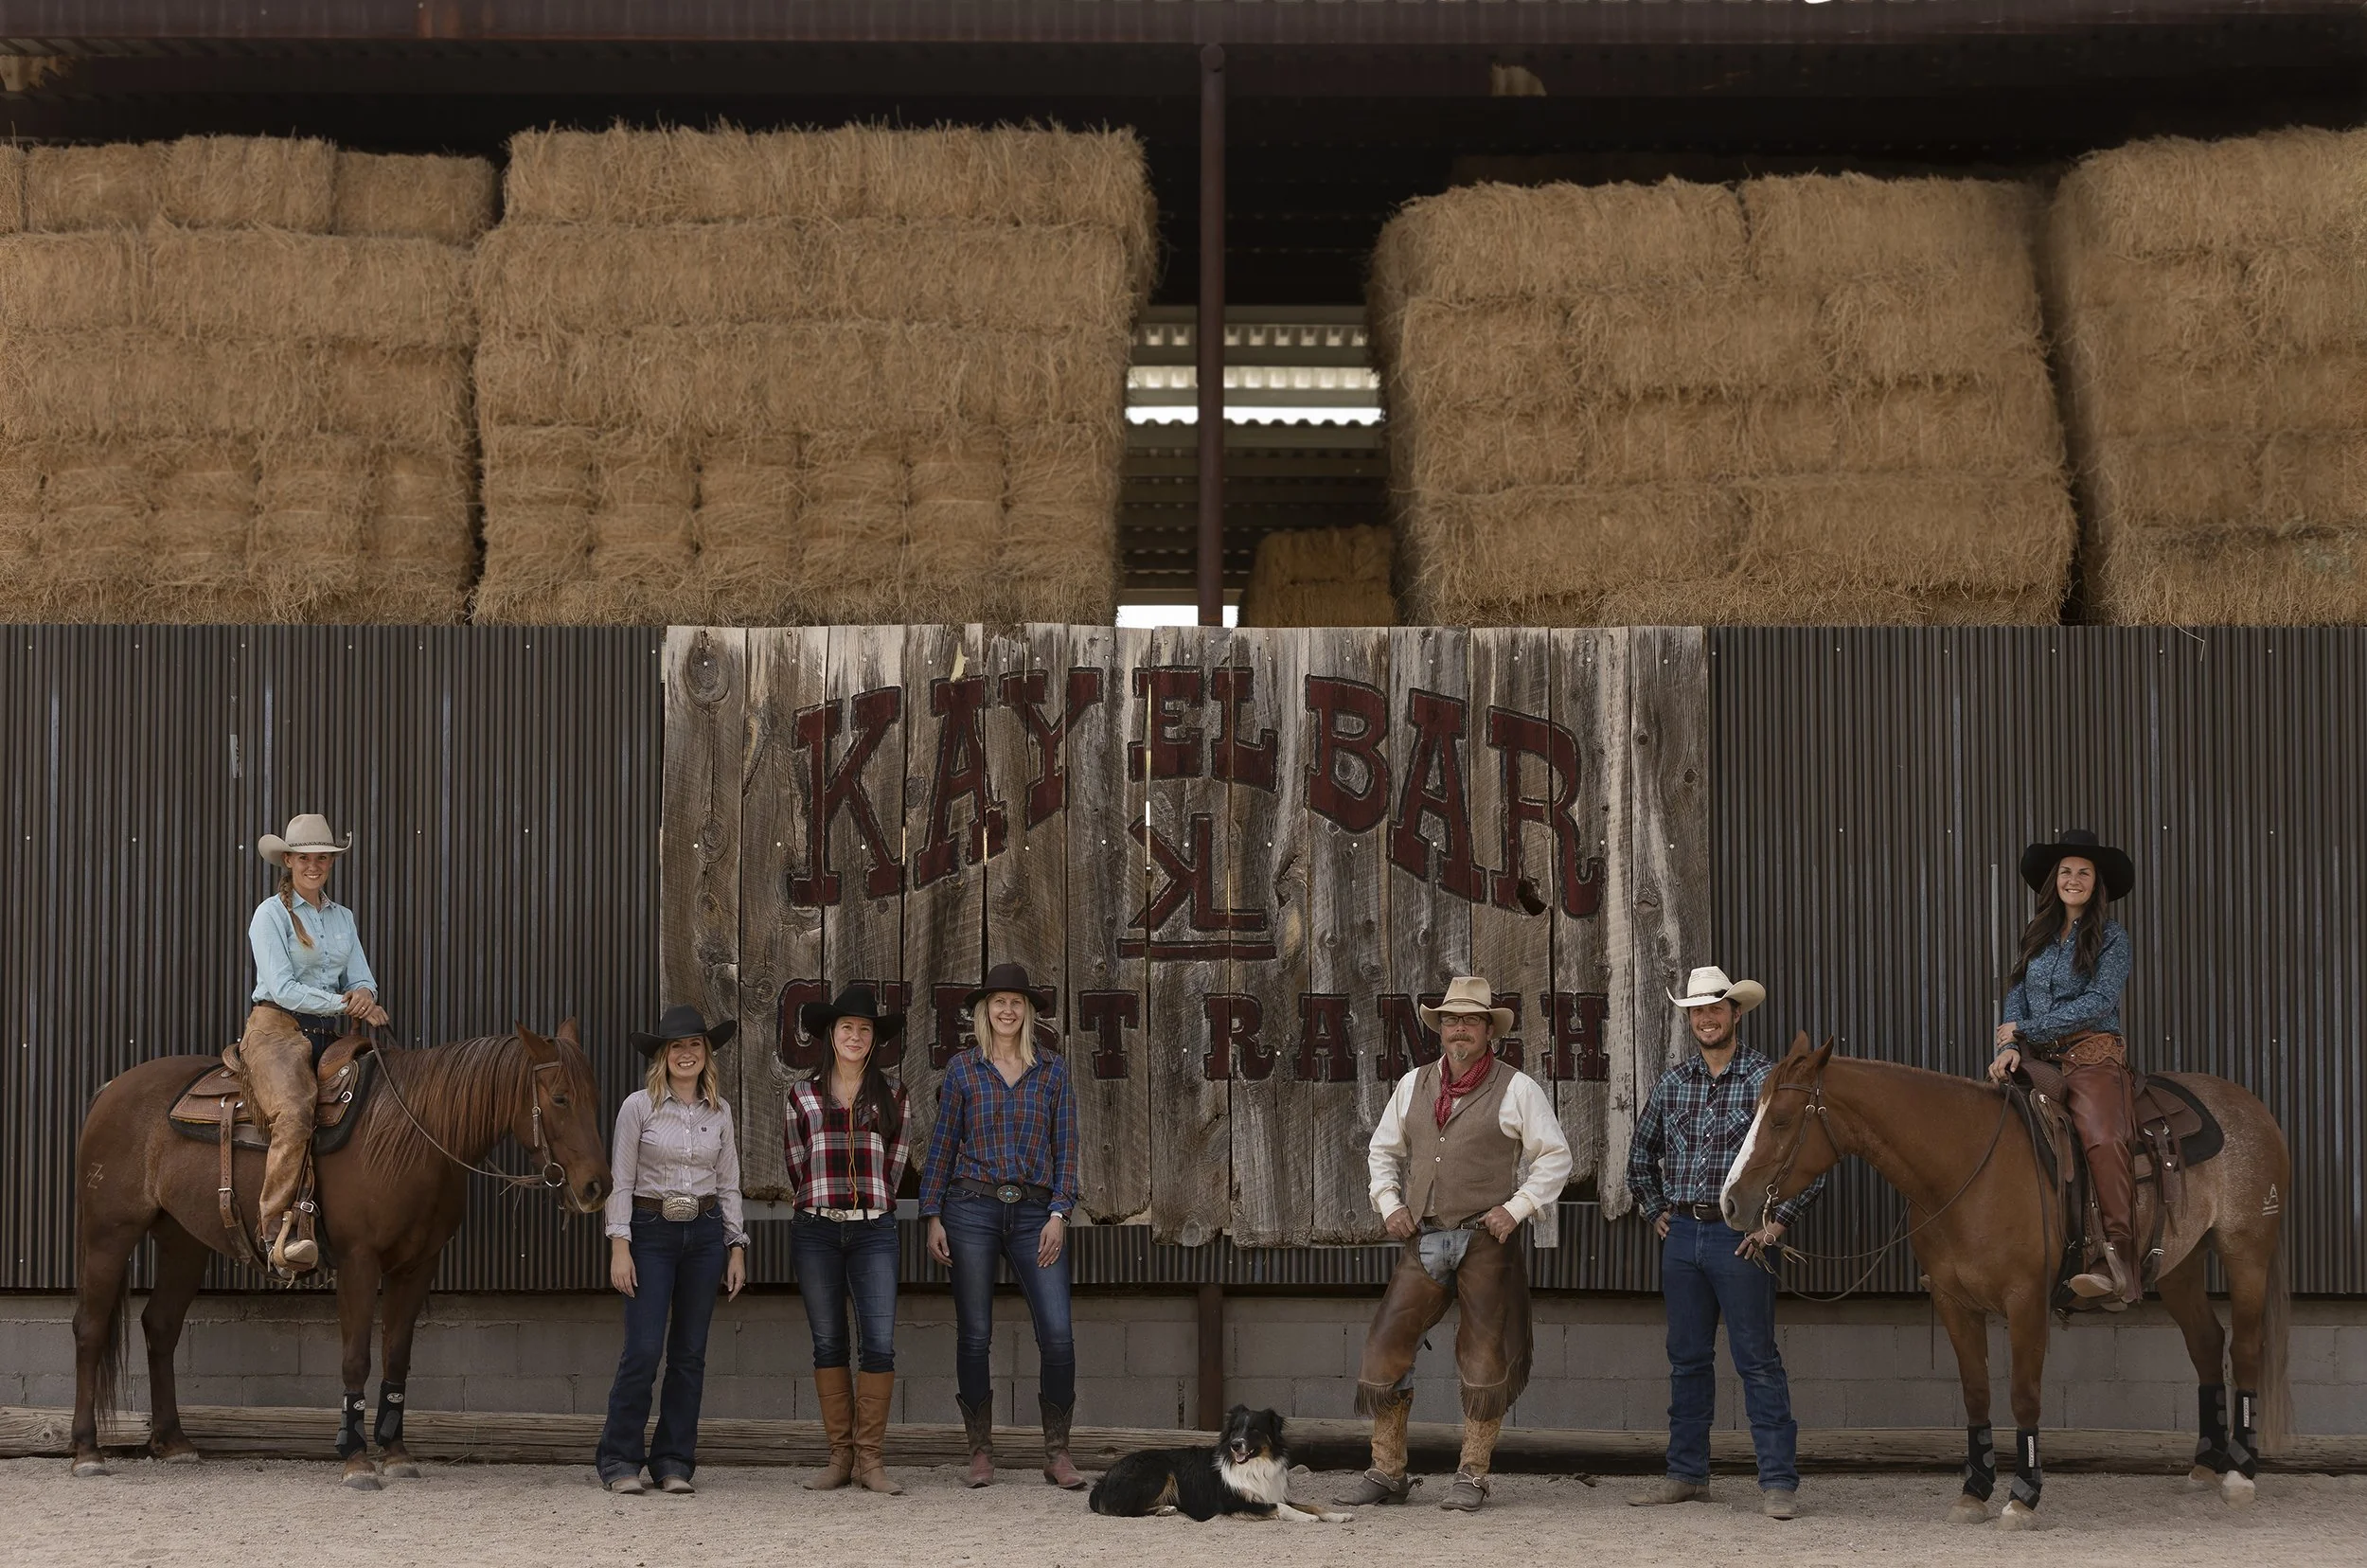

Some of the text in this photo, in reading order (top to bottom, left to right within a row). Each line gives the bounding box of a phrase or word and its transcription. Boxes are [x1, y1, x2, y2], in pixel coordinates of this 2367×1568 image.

[787, 666, 1606, 919] KAY EL BAR
